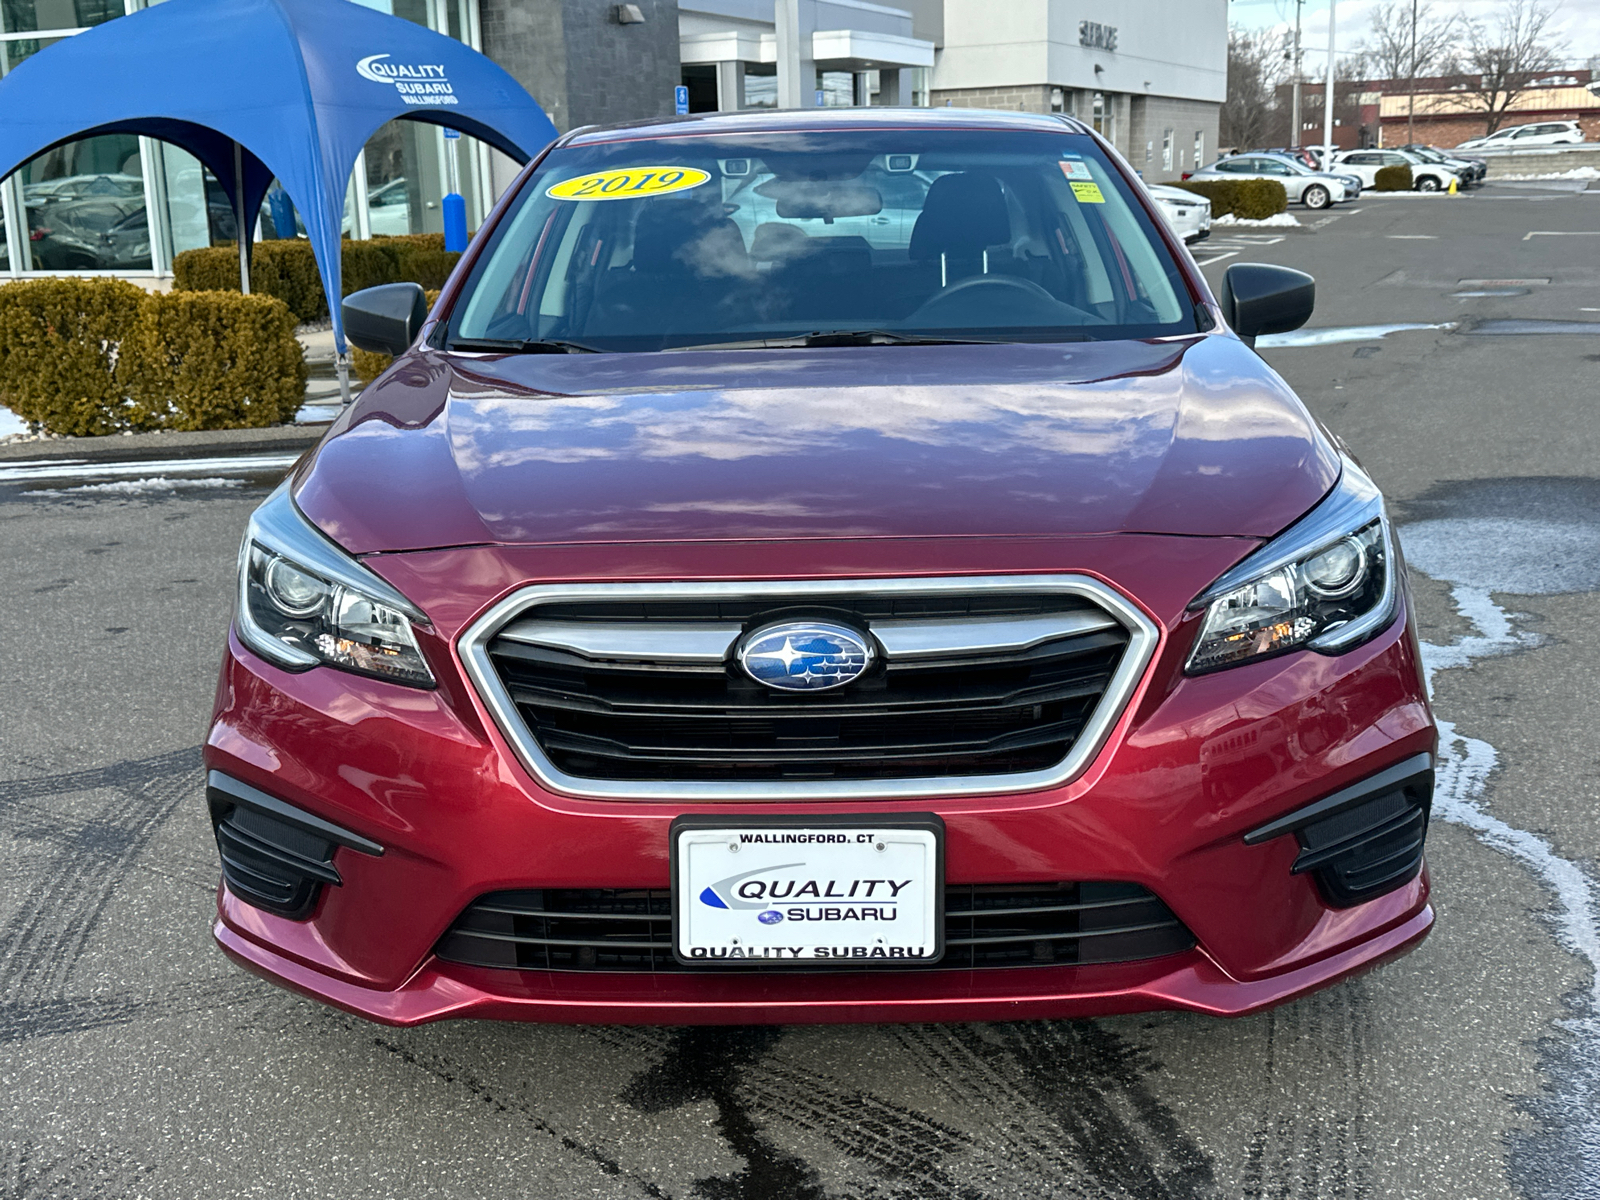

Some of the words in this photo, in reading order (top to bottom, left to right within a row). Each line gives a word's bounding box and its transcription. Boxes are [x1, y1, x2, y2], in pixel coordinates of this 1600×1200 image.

[371, 63, 445, 77] QUALITY
[395, 83, 453, 94] SUBARU
[400, 95, 459, 105] WALLINGFORD
[571, 171, 685, 197] 2019
[856, 834, 875, 844] CT
[738, 880, 912, 899] QUALITY
[787, 907, 898, 921] SUBARU
[690, 946, 804, 958] QUALITY
[813, 946, 924, 958] SUBARU
